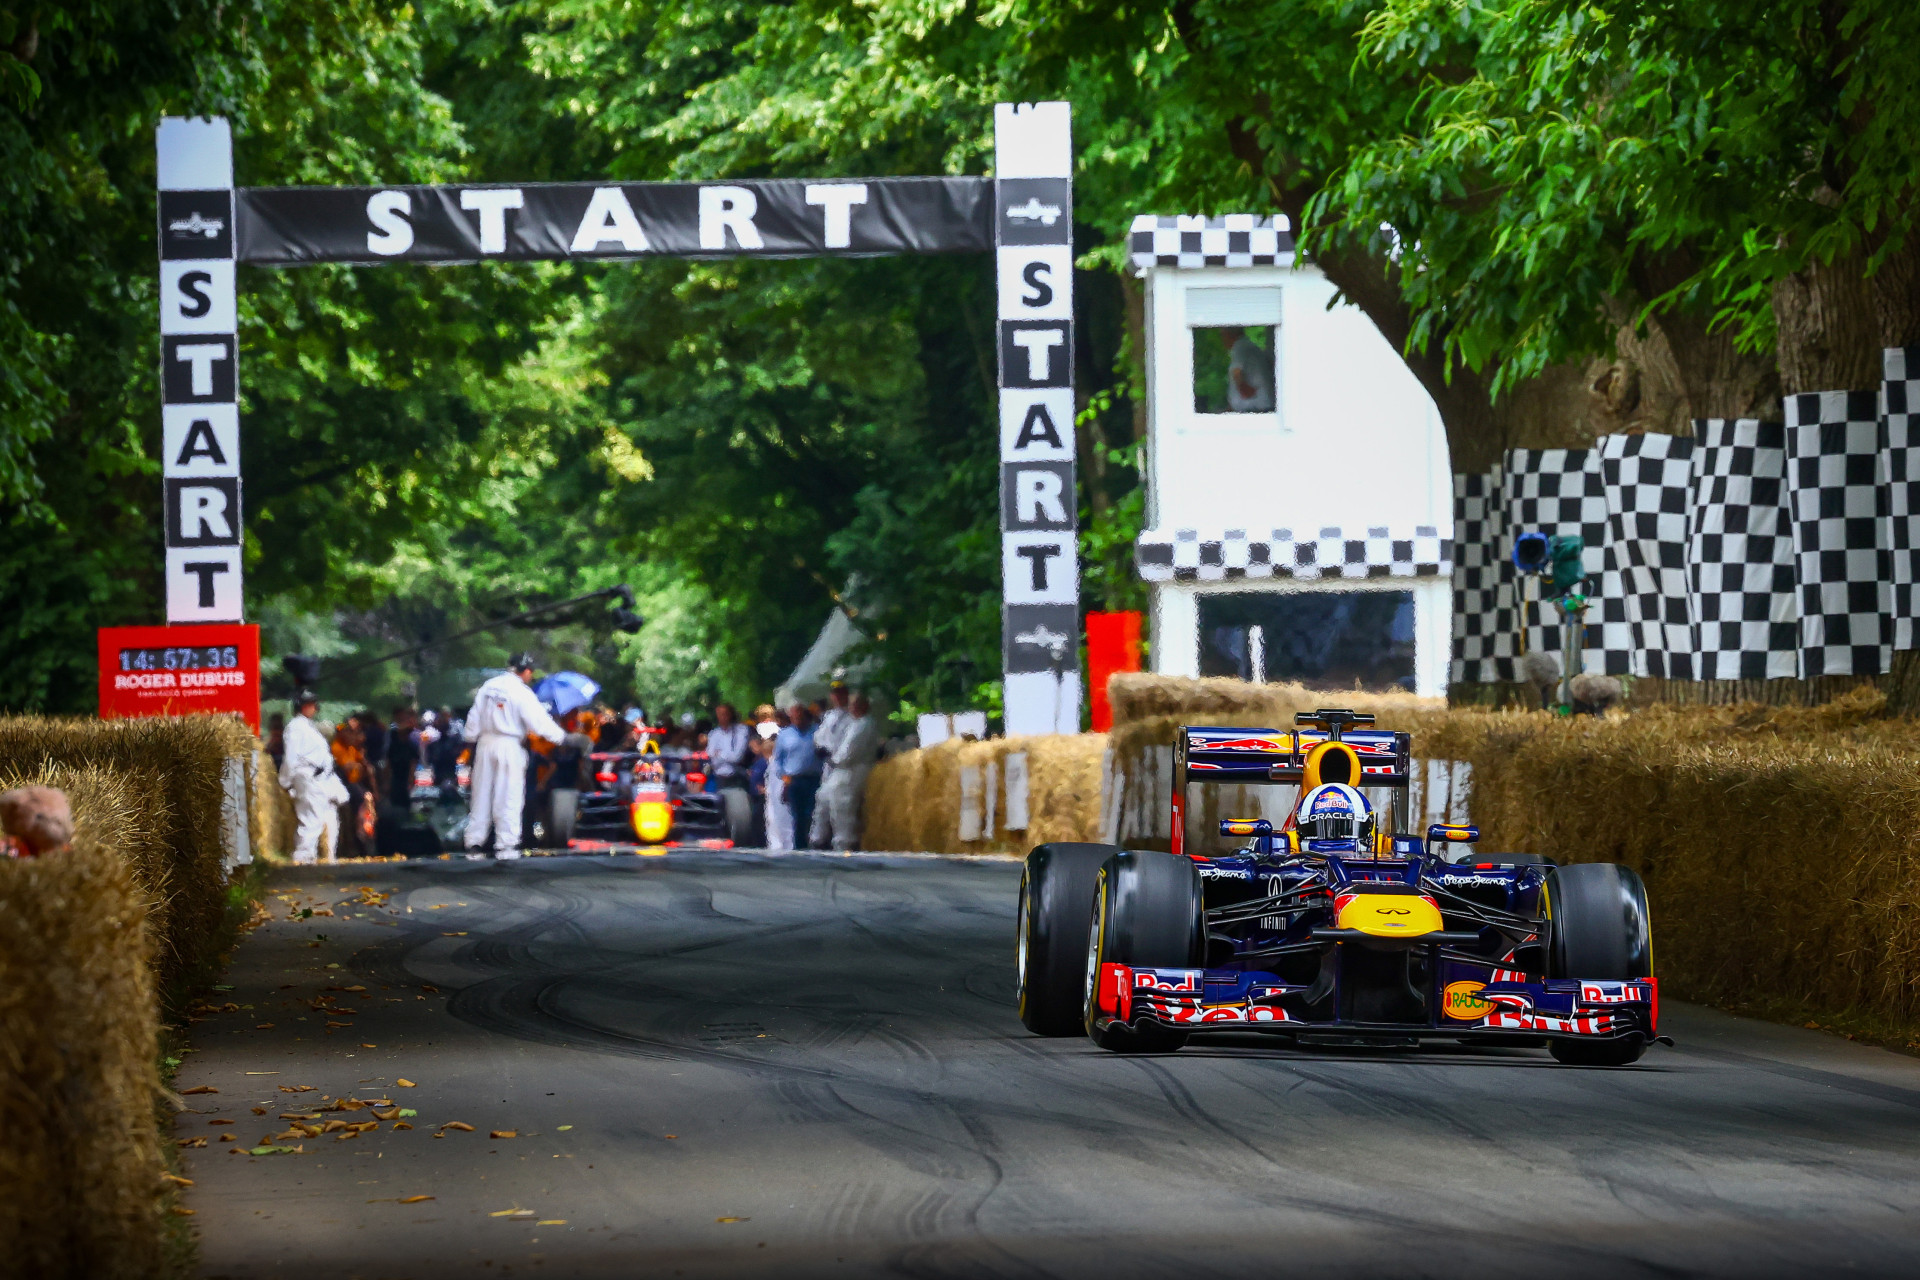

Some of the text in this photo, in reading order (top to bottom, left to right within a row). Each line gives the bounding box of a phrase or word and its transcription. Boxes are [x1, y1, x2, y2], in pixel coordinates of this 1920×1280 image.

[366, 184, 868, 256] START
[1013, 262, 1068, 591] START
[175, 270, 232, 608] START
[115, 671, 245, 689] ROGER DUBUIS
[1315, 800, 1348, 809] Red Bull
[1309, 812, 1353, 821] ORACLE
[1443, 874, 1473, 888] Pepe
[1471, 875, 1514, 888] Jeans
[1260, 915, 1287, 931] INFINITI
